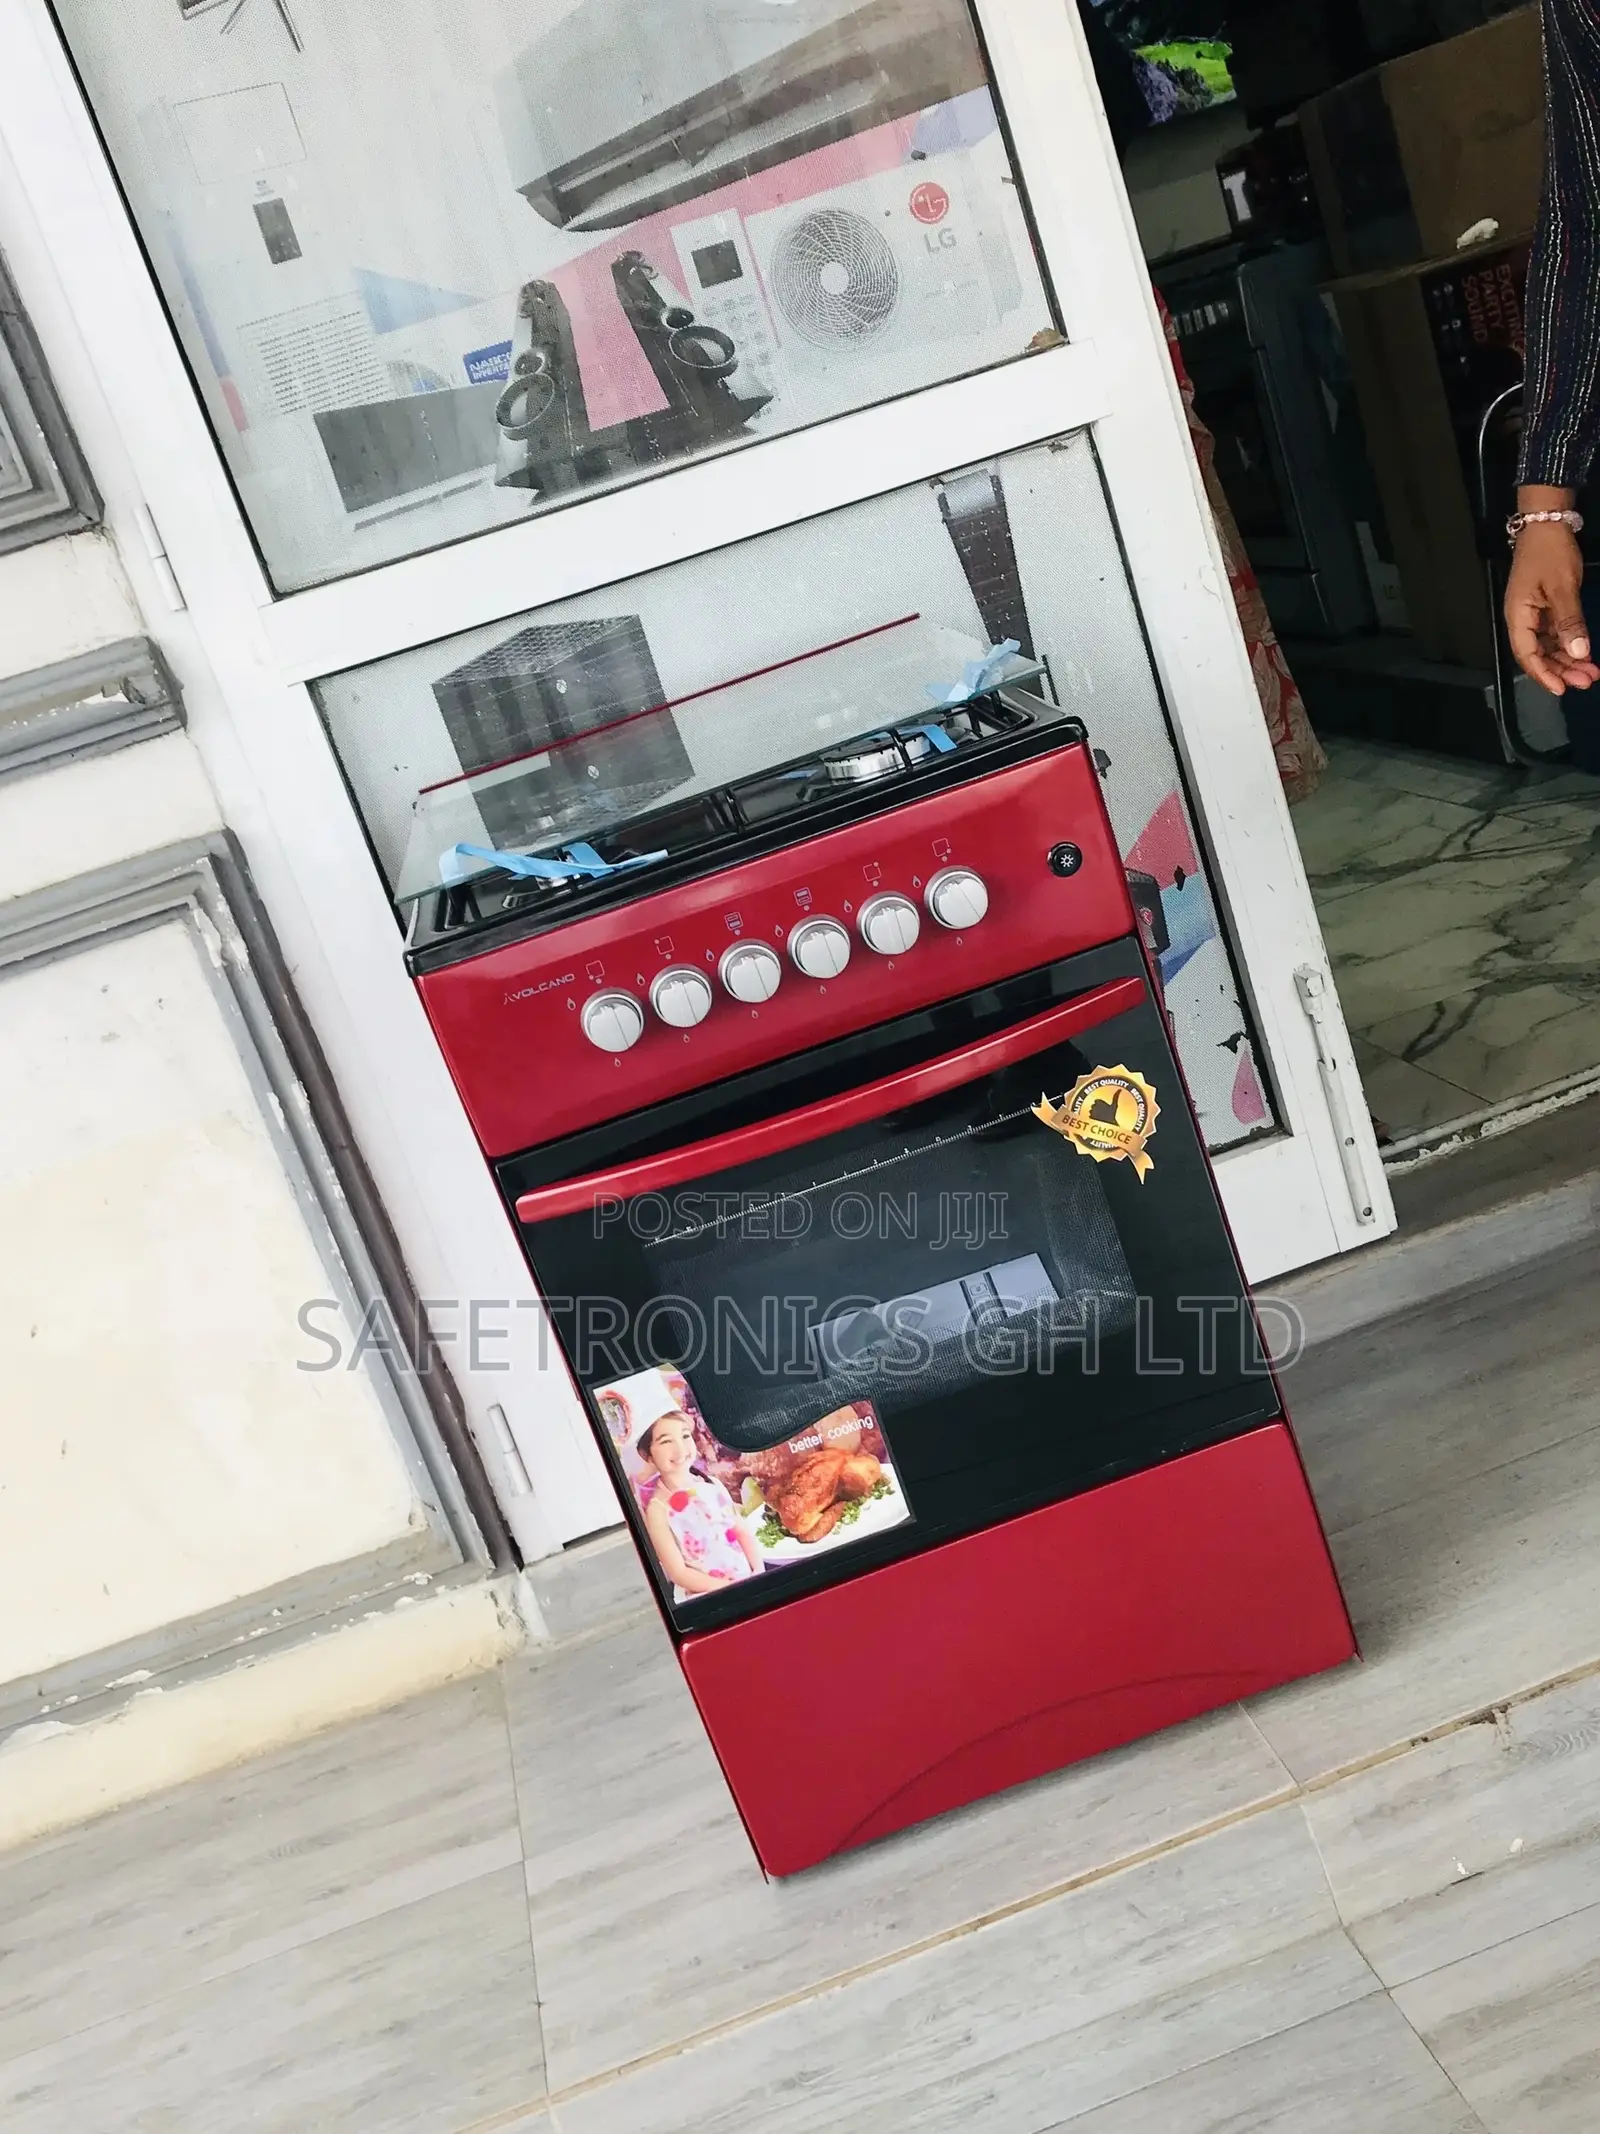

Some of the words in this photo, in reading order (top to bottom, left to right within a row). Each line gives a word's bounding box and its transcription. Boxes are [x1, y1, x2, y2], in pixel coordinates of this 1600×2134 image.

[924, 228, 957, 253] LG
[512, 973, 576, 1000] VOLCANO
[1084, 1081, 1101, 1095] BEST
[1099, 1078, 1130, 1088] QUALITY
[1062, 1114, 1090, 1132] BEST
[1090, 1124, 1132, 1145] CHOICE
[788, 1433, 824, 1454] better
[827, 1415, 874, 1440] cooking
